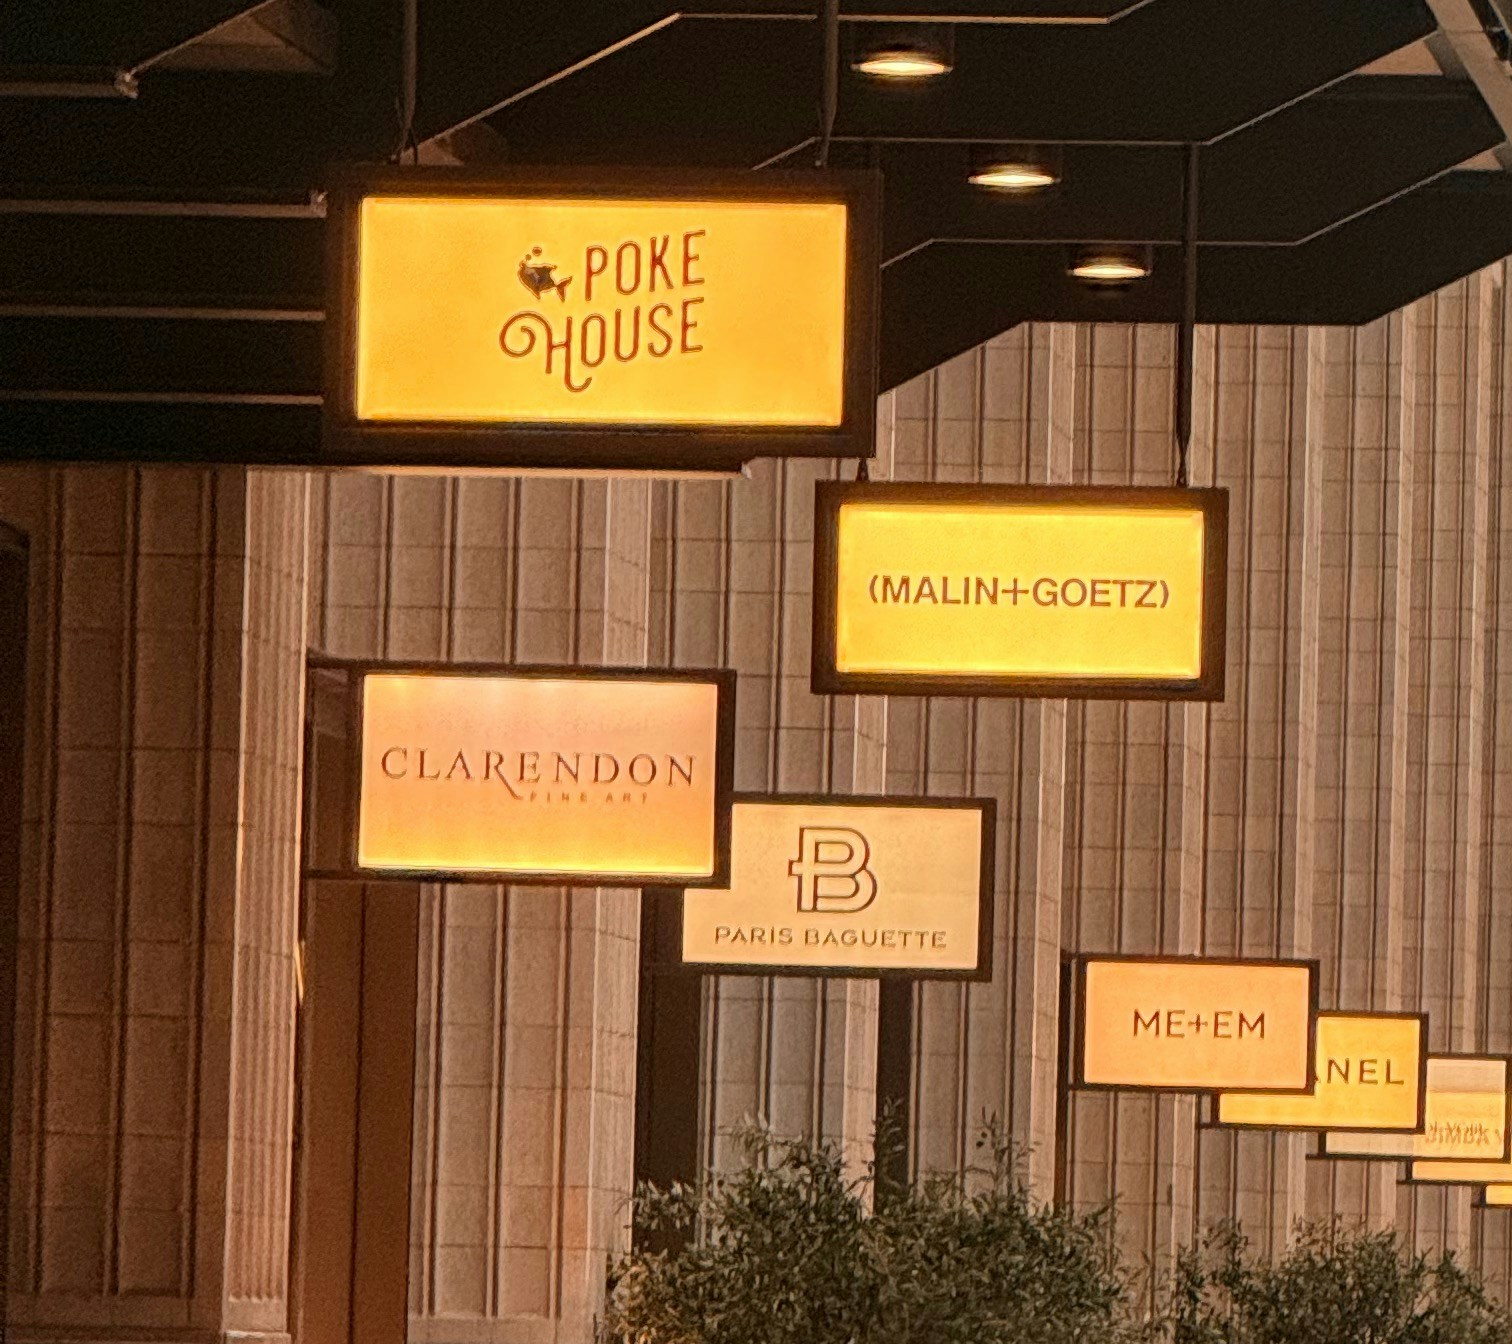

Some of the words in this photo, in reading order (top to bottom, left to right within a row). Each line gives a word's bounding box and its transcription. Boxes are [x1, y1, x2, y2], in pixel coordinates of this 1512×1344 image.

[585, 229, 706, 302] POKE
[499, 297, 705, 392] HOUSE
[869, 574, 1170, 609] (MALIN+GOETZ)
[380, 745, 697, 800] CLARENDON
[530, 791, 588, 804] FINE
[606, 791, 648, 805] ART
[715, 926, 793, 946] PARIS
[805, 927, 947, 949] BAGUETTE
[1133, 1009, 1265, 1039] ME+EM
[1314, 1058, 1404, 1086] NEL
